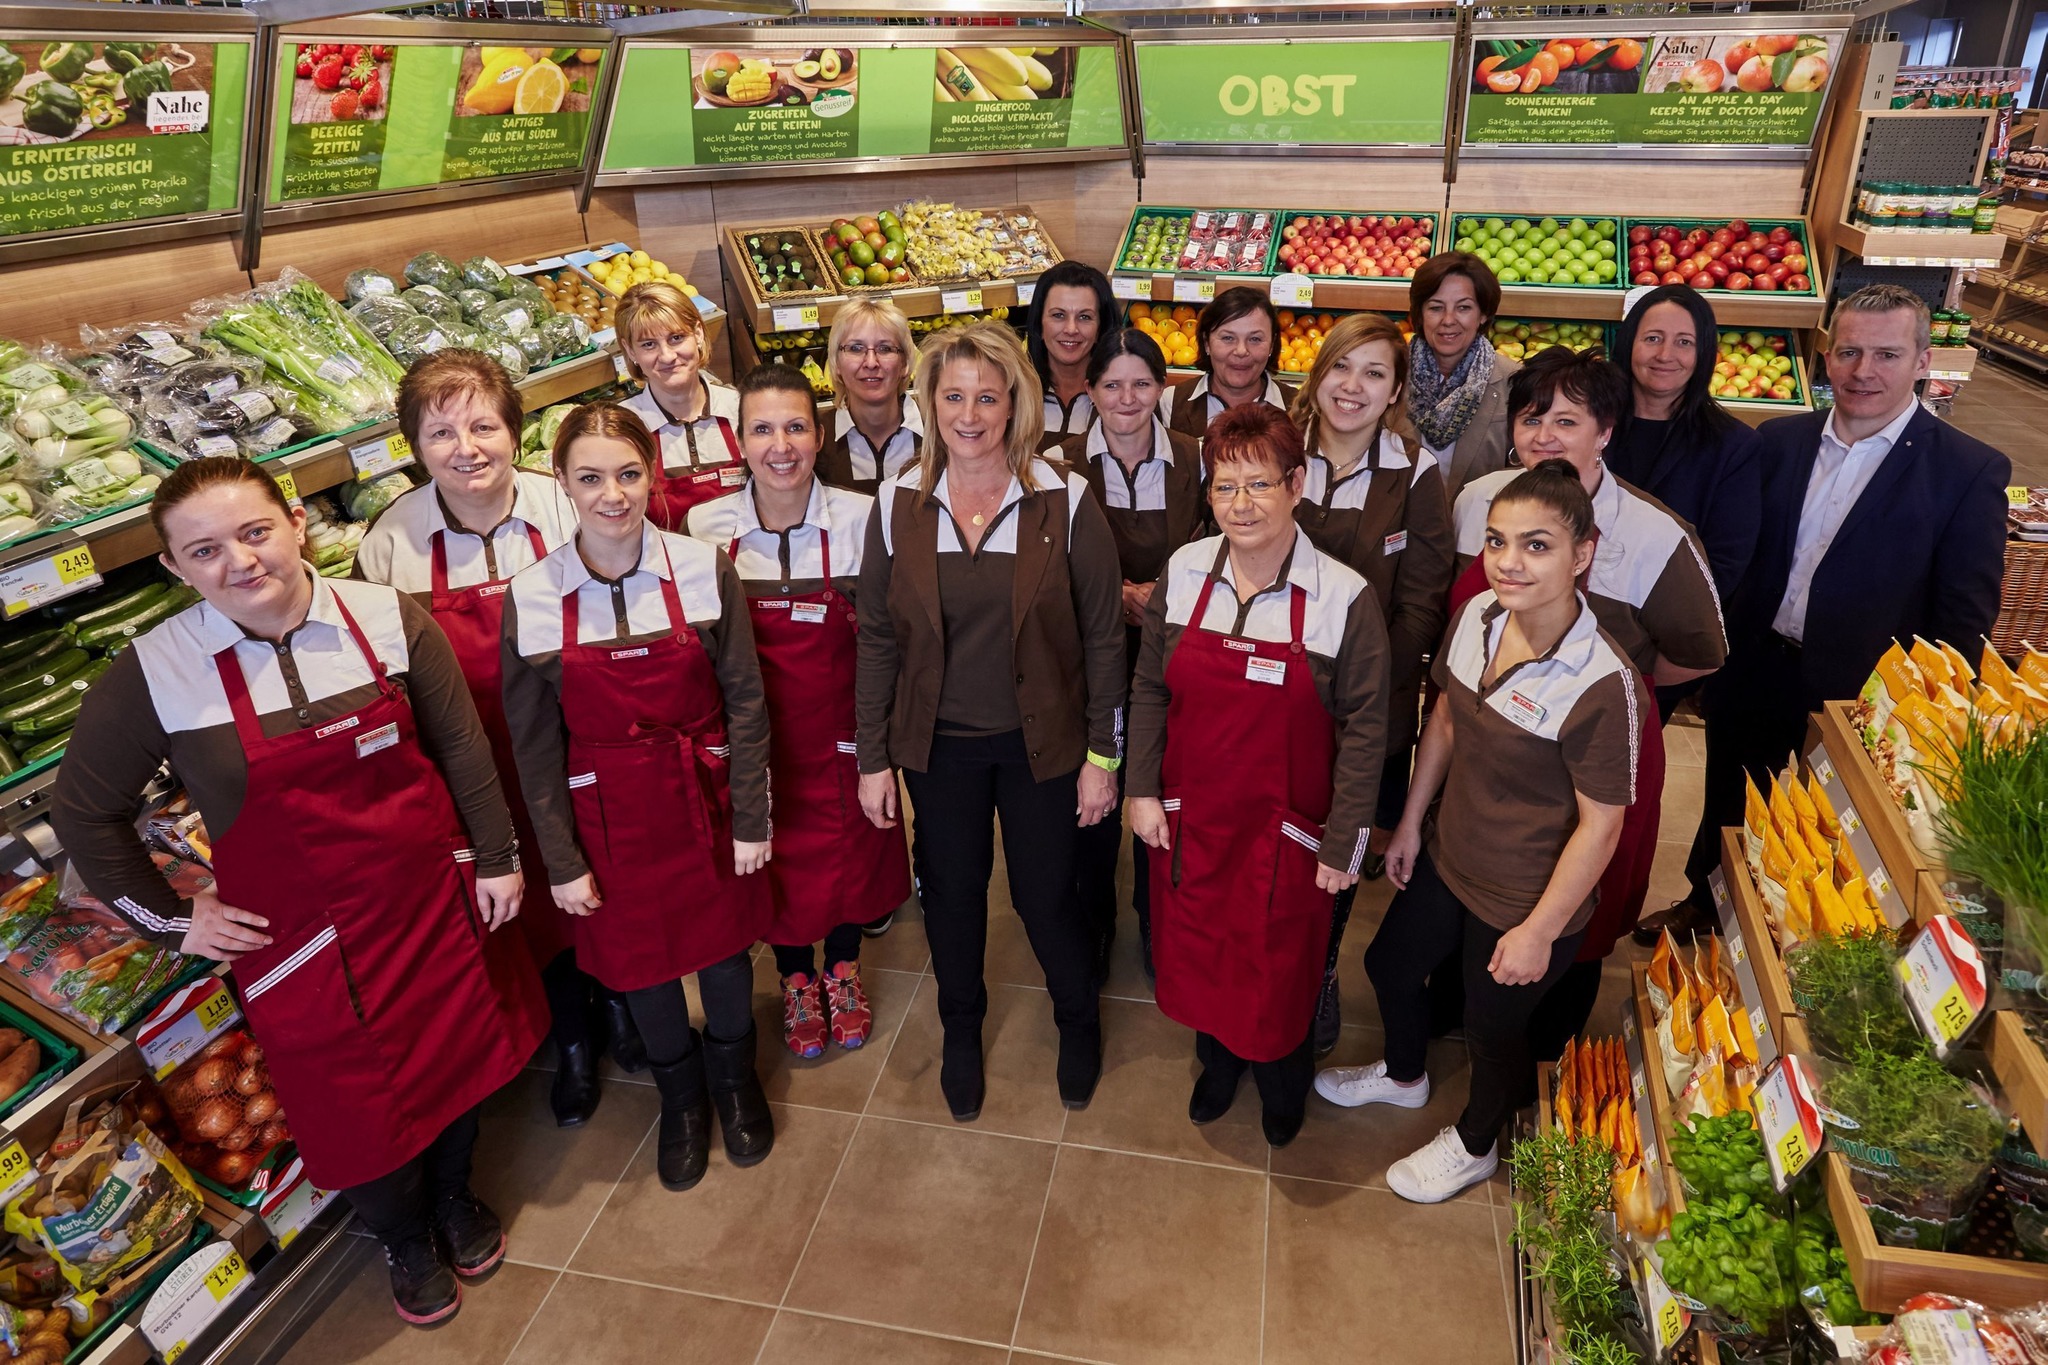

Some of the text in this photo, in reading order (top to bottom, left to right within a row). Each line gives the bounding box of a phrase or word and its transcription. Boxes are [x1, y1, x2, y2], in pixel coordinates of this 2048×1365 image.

[1219, 74, 1357, 117] OBST
[1505, 97, 1597, 106] SONNENENERGIE
[1679, 96, 1784, 105] AN APPLE A DAY
[154, 95, 202, 114] Nahe
[814, 97, 852, 112] Genussreif
[975, 102, 1033, 112] FINGERFOOD.
[748, 109, 807, 120] ZUGREIFEN
[1526, 108, 1572, 117] TANKEN!
[1650, 107, 1808, 116] KEEPS THE DOCTOR AWAY
[502, 116, 544, 128] SAFTIGES
[952, 114, 1004, 124] BIOLOGISCH
[1488, 118, 1521, 127] Saftige
[1676, 118, 1706, 127] besagt
[1722, 118, 1744, 126] altes
[1747, 118, 1798, 128] Sprichwort!
[160, 124, 190, 132] SPAR
[310, 124, 365, 139] BEERIGE
[734, 120, 821, 132] AUF DIE REIFEN!
[1478, 127, 1528, 135] Clementinen
[1550, 127, 1565, 135] den
[1567, 128, 1615, 136] sonnigsten
[1686, 128, 1698, 136] Sie
[1732, 128, 1756, 136] bunte
[1767, 128, 1805, 137] knackig-
[481, 128, 558, 143] AUS DEM SÜDEN
[703, 131, 819, 143] Nicht länger warten mit den
[12, 142, 137, 166] ERNTEFRISCH
[312, 140, 361, 155] ZEITEN
[468, 146, 487, 156] SPAR
[710, 141, 848, 154] Vorgereifte Mangos und Avocados
[310, 156, 359, 167] Die süssen
[471, 158, 487, 168] sich
[489, 154, 516, 168] perfekt
[719, 151, 836, 163] können Sie sofort geniessen!
[43, 159, 153, 183] ÖSTERREICH
[285, 165, 378, 183] Früchtchen starten
[11, 186, 84, 203] knackigen
[90, 181, 137, 198] grünen
[142, 175, 187, 191] Paprika
[284, 179, 372, 199] jetzt in die Saison!
[27, 204, 76, 220] frisch
[80, 204, 105, 213] aus
[110, 199, 133, 210] der
[138, 194, 180, 208] Region
[1139, 283, 1150, 291] 1,99
[1202, 285, 1213, 293] 1,99
[1299, 289, 1312, 297] 2,49
[804, 310, 817, 319] 1,49
[391, 437, 408, 452] 1,99
[2012, 490, 2026, 499] 1,79
[62, 552, 90, 573] 2,49
[1227, 641, 1248, 650] SPAR
[1256, 660, 1277, 669] SPAR
[1516, 697, 1536, 713] SPAR
[323, 721, 349, 735] SPAR
[28, 923, 59, 948] Bio
[206, 994, 230, 1018] 1,19
[1944, 995, 1967, 1031] 2,79
[147, 1041, 158, 1051] BIO
[1786, 1134, 1804, 1168] 2,79
[1831, 1133, 1900, 1168] ymian
[0, 1151, 23, 1179] ,99
[94, 1182, 122, 1214] Erdäpfel
[170, 1266, 194, 1291] STEIRER
[214, 1258, 240, 1288] 1,49
[1666, 1306, 1679, 1339] 2,79
[171, 1346, 183, 1358] 20
